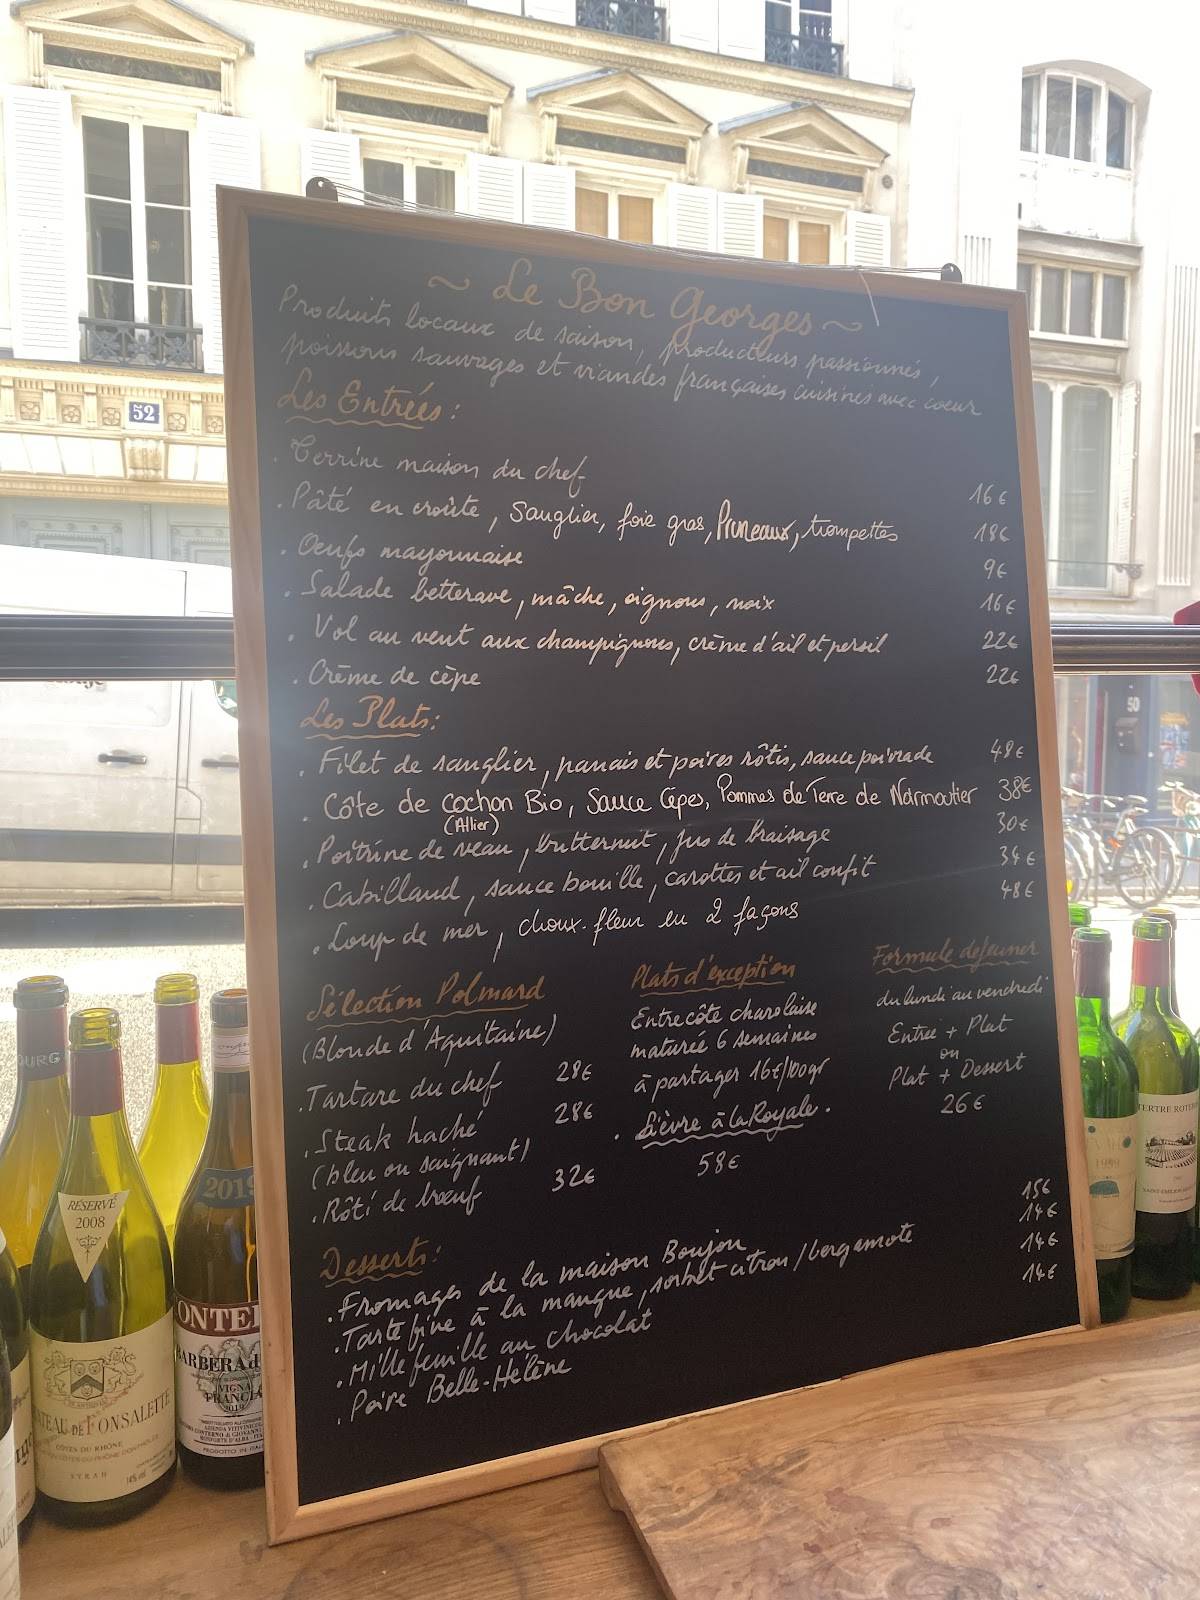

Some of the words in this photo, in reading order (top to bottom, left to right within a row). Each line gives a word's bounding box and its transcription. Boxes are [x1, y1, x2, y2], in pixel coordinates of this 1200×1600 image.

[405, 302, 496, 337] locaux
[514, 320, 545, 343] de
[493, 257, 543, 306] Le
[558, 266, 655, 320] Bon
[670, 287, 812, 350] Georges
[276, 367, 327, 411] Les
[411, 346, 526, 387] sauvages
[537, 352, 574, 377] et
[574, 360, 667, 388] viandes
[673, 362, 787, 402] françaises
[132, 403, 156, 422] 52
[290, 435, 383, 470] Terrine
[396, 451, 479, 481] maison
[493, 458, 527, 482] du
[535, 455, 588, 499] chef
[291, 480, 353, 514] Pâté
[370, 499, 404, 516] en
[616, 501, 657, 542] foie
[800, 513, 899, 551] trompettes
[380, 544, 524, 576] mayonnaise
[300, 568, 394, 600] Salade
[311, 613, 359, 643] Vol
[368, 628, 401, 646] au
[411, 624, 476, 648] vent
[481, 632, 531, 651] aux
[688, 633, 748, 654] crème
[806, 634, 829, 654] et
[824, 632, 890, 663] persil
[981, 629, 1020, 651] 22€
[308, 659, 388, 688] Crème
[390, 664, 420, 686] de
[429, 664, 482, 693] cèpe
[984, 663, 1020, 686] 22€
[299, 696, 345, 730] Les
[1126, 696, 1141, 713] 50
[318, 745, 386, 776] Filet
[393, 753, 424, 775] de
[432, 746, 538, 785] sanglier
[555, 748, 640, 783] panais
[644, 747, 674, 770] et
[669, 750, 733, 779] poires
[801, 749, 857, 766] sauce
[855, 744, 935, 773] poivrade
[323, 790, 385, 820] Côte
[398, 787, 431, 816] de
[586, 786, 653, 814] Sauce
[716, 772, 776, 805] Pommes
[782, 780, 803, 805] de
[855, 782, 882, 806] de
[997, 776, 1033, 802] 38€
[316, 835, 414, 866] Poitrine
[419, 838, 446, 862] de
[453, 840, 514, 860] veau
[717, 827, 739, 848] de
[995, 811, 1030, 835] 30€
[322, 871, 461, 912] Cabillaud
[484, 878, 555, 899] sauce
[664, 863, 742, 889] carottes
[749, 861, 773, 884] et
[775, 856, 811, 882] ail
[812, 853, 878, 889] confit
[327, 921, 397, 962] Loup
[402, 922, 428, 949] de
[442, 921, 489, 943] mer
[705, 896, 722, 926] 2
[733, 895, 800, 937] façons
[1000, 878, 1035, 901] 48€
[630, 960, 688, 991] Plats
[876, 989, 901, 1008] du
[902, 985, 953, 1006] lundi
[951, 989, 973, 1002] au
[976, 976, 1050, 1001] vendredi
[729, 991, 819, 1023] charolaise
[965, 1013, 1015, 1036] Plat
[716, 1027, 730, 1051] 6
[732, 1023, 818, 1050] semaines
[939, 1047, 960, 1061] ou
[305, 1079, 402, 1113] Tartare
[410, 1076, 443, 1100] du
[450, 1061, 503, 1109] chef
[555, 1058, 593, 1083] 28€
[633, 1073, 652, 1093] à
[651, 1062, 740, 1104] partager
[888, 1064, 930, 1091] Plat
[960, 1051, 1028, 1080] Dessert
[313, 1123, 393, 1154] Steak
[406, 1110, 484, 1145] haché
[554, 1101, 594, 1125] 28€
[634, 1108, 702, 1142] Lièvre
[711, 1110, 727, 1129] à
[384, 1162, 411, 1180] ou
[697, 1150, 742, 1177] 58€
[322, 1190, 378, 1226] Rôti
[383, 1191, 406, 1214] de
[551, 1164, 596, 1193] 32€
[75, 1216, 105, 1229] 2008
[337, 1284, 463, 1323] Fromages
[478, 1270, 507, 1298] de
[521, 1259, 549, 1288] la
[559, 1251, 650, 1282] maison
[342, 1320, 407, 1353] Tarte
[406, 1313, 456, 1354] fine
[469, 1306, 490, 1327] à
[499, 1293, 527, 1320] la
[541, 1284, 634, 1319] mangue
[349, 1348, 406, 1387] Mille
[499, 1340, 537, 1357] au
[546, 1306, 653, 1350] chocolat
[350, 1389, 408, 1423] Poire
